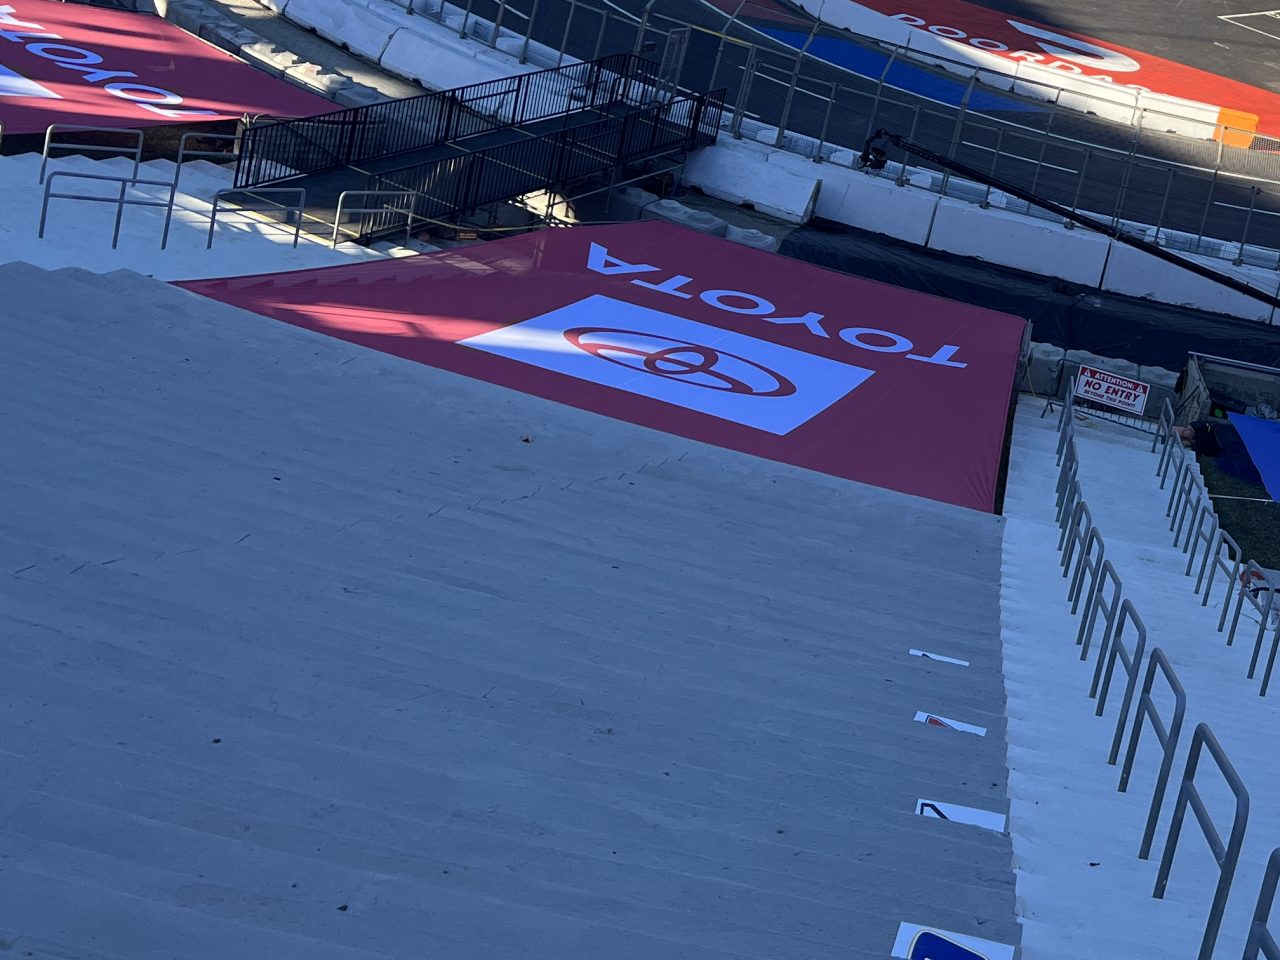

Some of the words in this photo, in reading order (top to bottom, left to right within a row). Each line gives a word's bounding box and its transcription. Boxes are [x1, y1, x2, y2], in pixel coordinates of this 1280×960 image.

[888, 13, 1152, 92] DOORD
[586, 241, 968, 368] TOYOTA
[1083, 379, 1102, 391] NO
[1104, 385, 1141, 403] ENTRY
[1094, 373, 1135, 390] ATTENTION:
[1083, 388, 1104, 399] BEYOND
[1105, 395, 1118, 403] THIS
